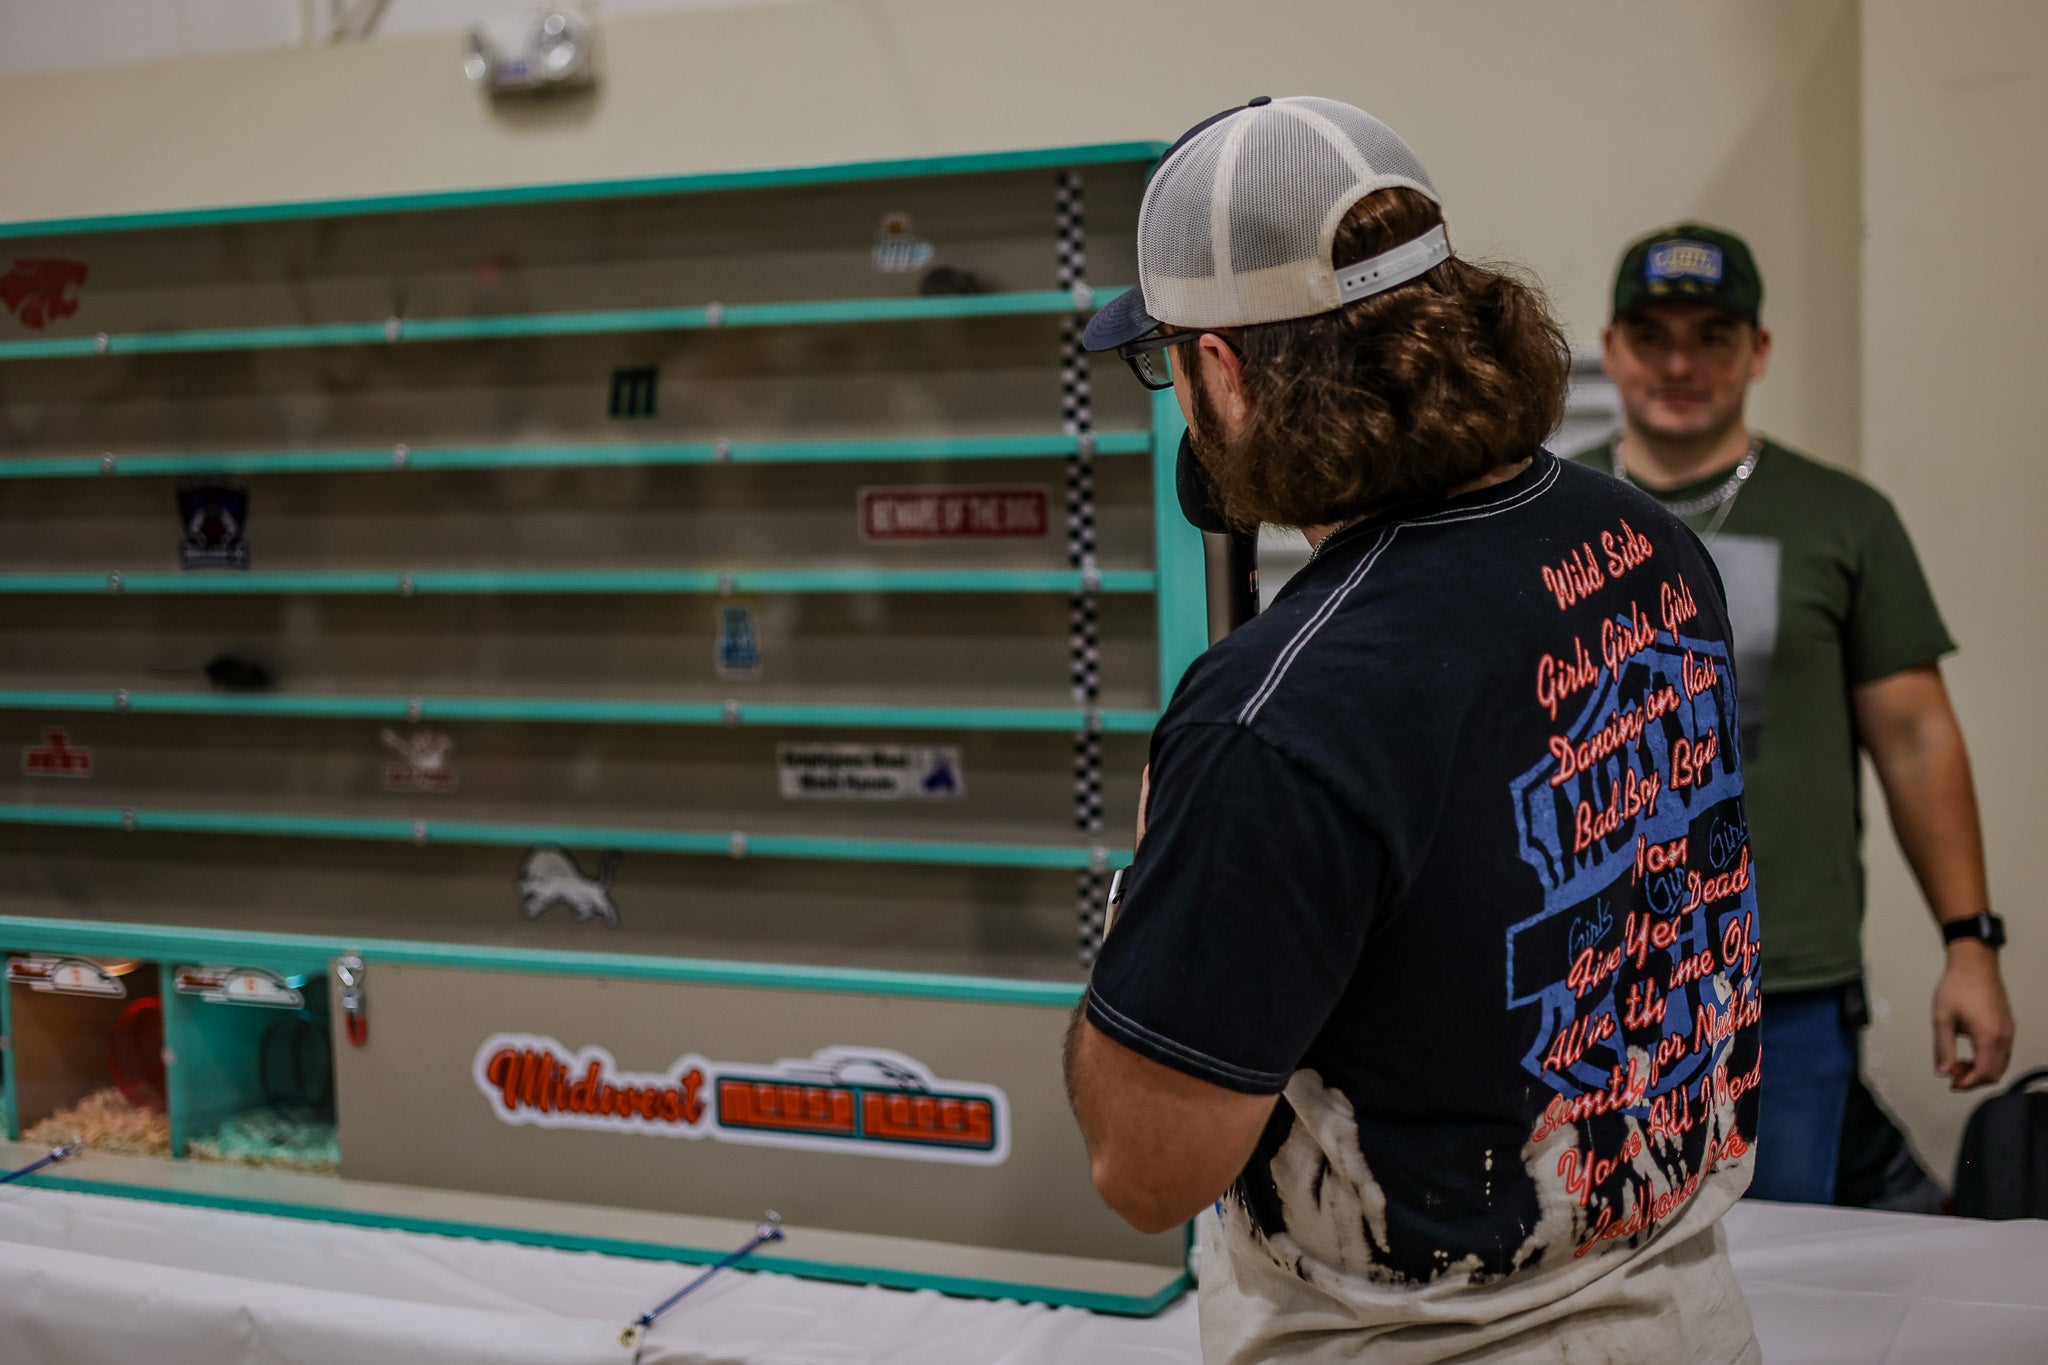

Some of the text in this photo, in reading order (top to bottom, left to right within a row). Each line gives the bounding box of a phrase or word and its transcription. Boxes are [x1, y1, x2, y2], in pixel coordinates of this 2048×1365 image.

[1541, 518, 1653, 611] Wild Side
[1660, 572, 1697, 644] Girls
[1549, 709, 1644, 787] Dancing
[1646, 685, 1680, 720] on
[1573, 779, 1619, 854] Bad
[1624, 767, 1661, 816] Boy
[1566, 945, 1621, 999] Five
[1681, 845, 1750, 915] Dead
[487, 1049, 703, 1125] Midwest
[1541, 1013, 1590, 1078] All
[1587, 1011, 1616, 1048] in
[1650, 1031, 1686, 1088] for
[1647, 1083, 1694, 1148] All
[1713, 1042, 1762, 1107] Need
